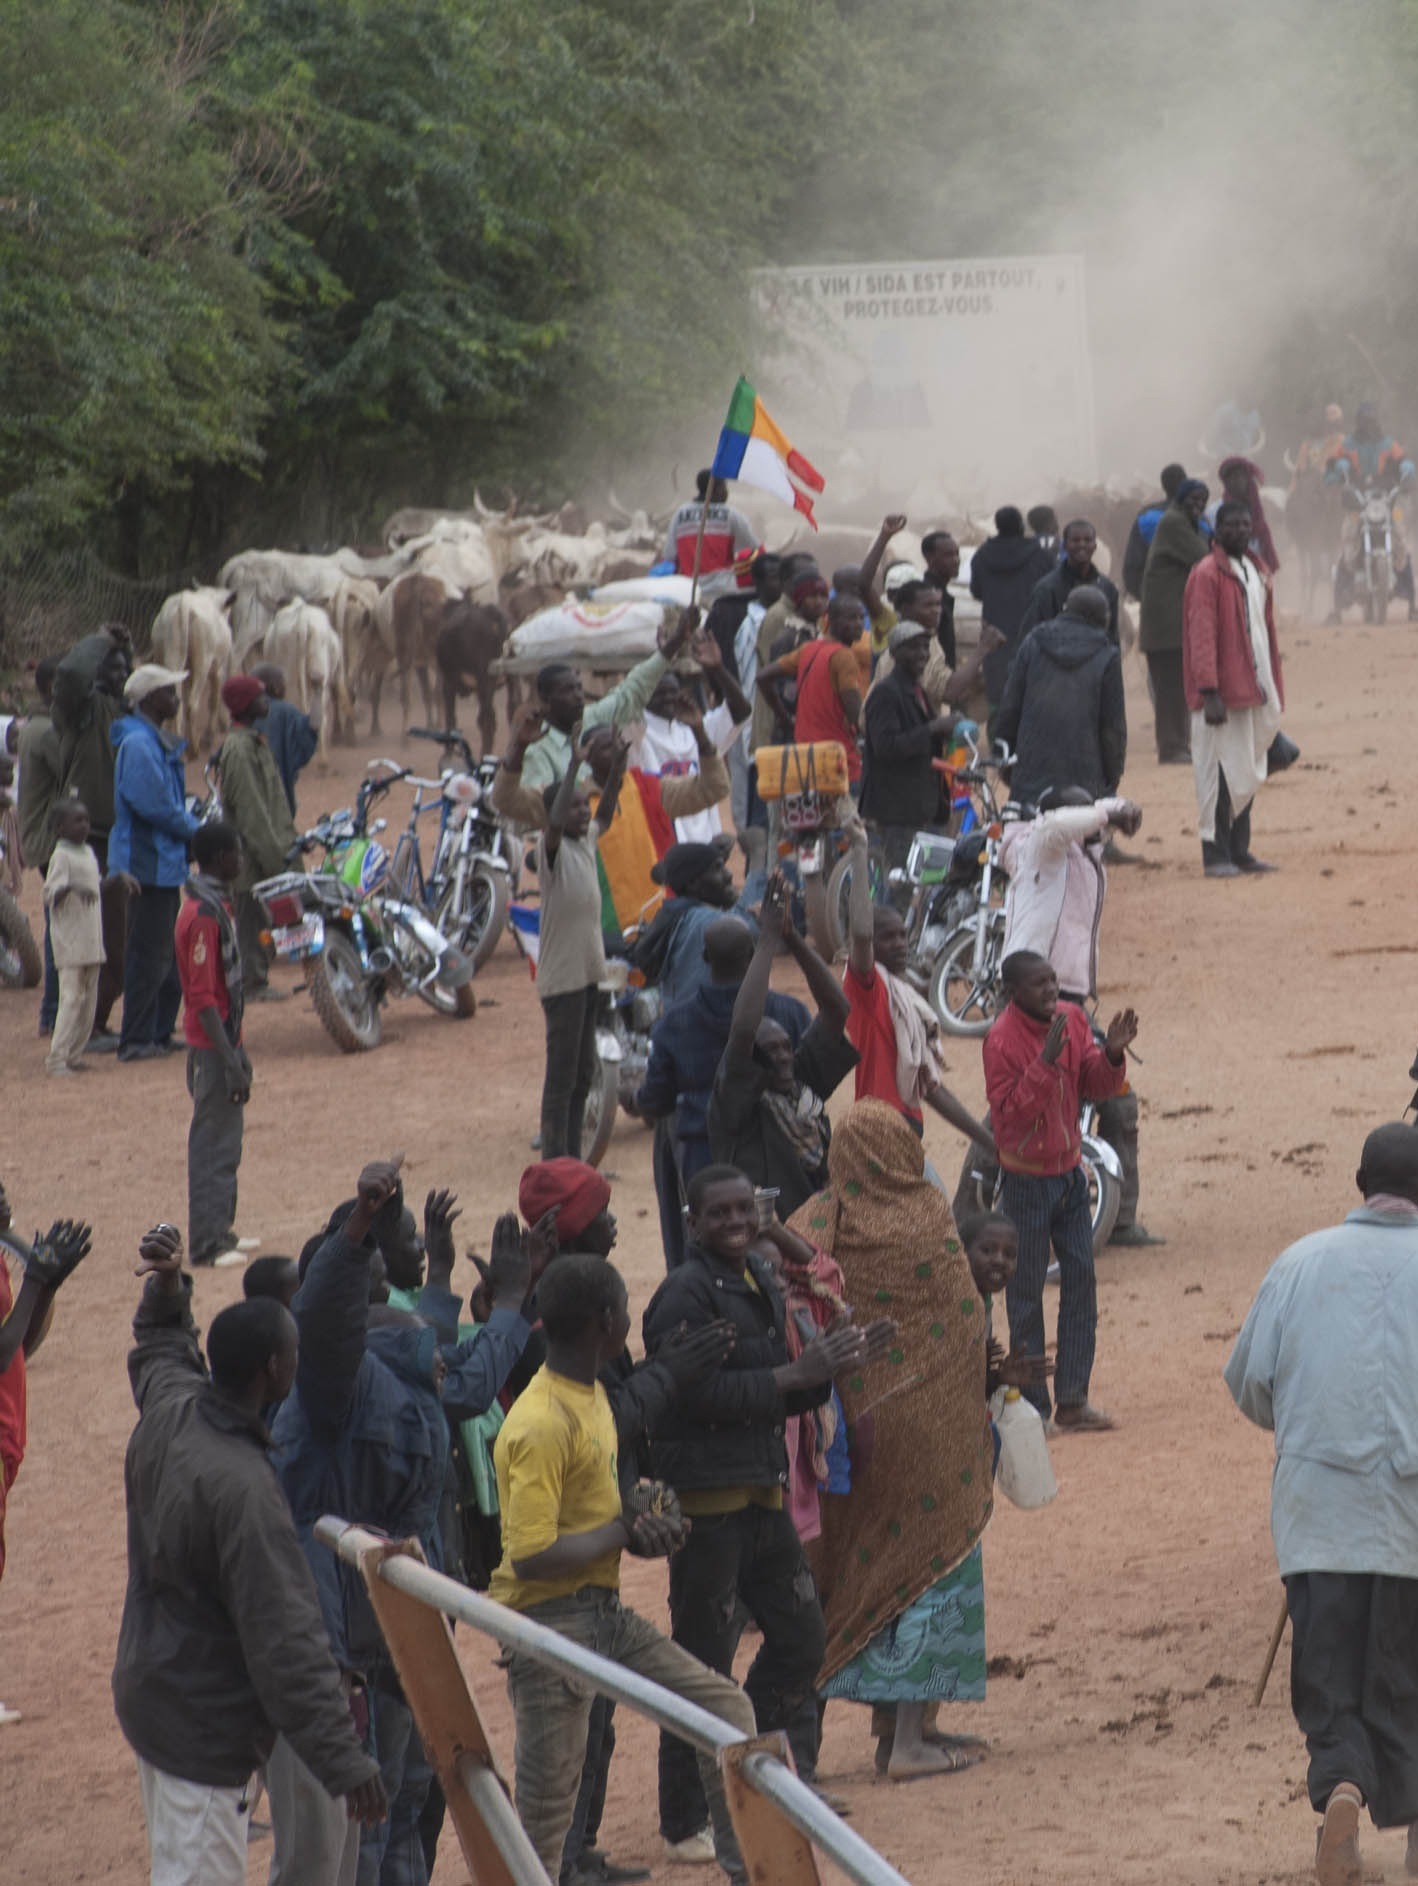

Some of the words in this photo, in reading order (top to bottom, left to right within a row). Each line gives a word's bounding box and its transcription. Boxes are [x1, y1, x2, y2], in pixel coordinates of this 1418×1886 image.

[820, 276, 850, 296] VIH
[866, 273, 907, 296] SIDA
[913, 271, 947, 293] EST
